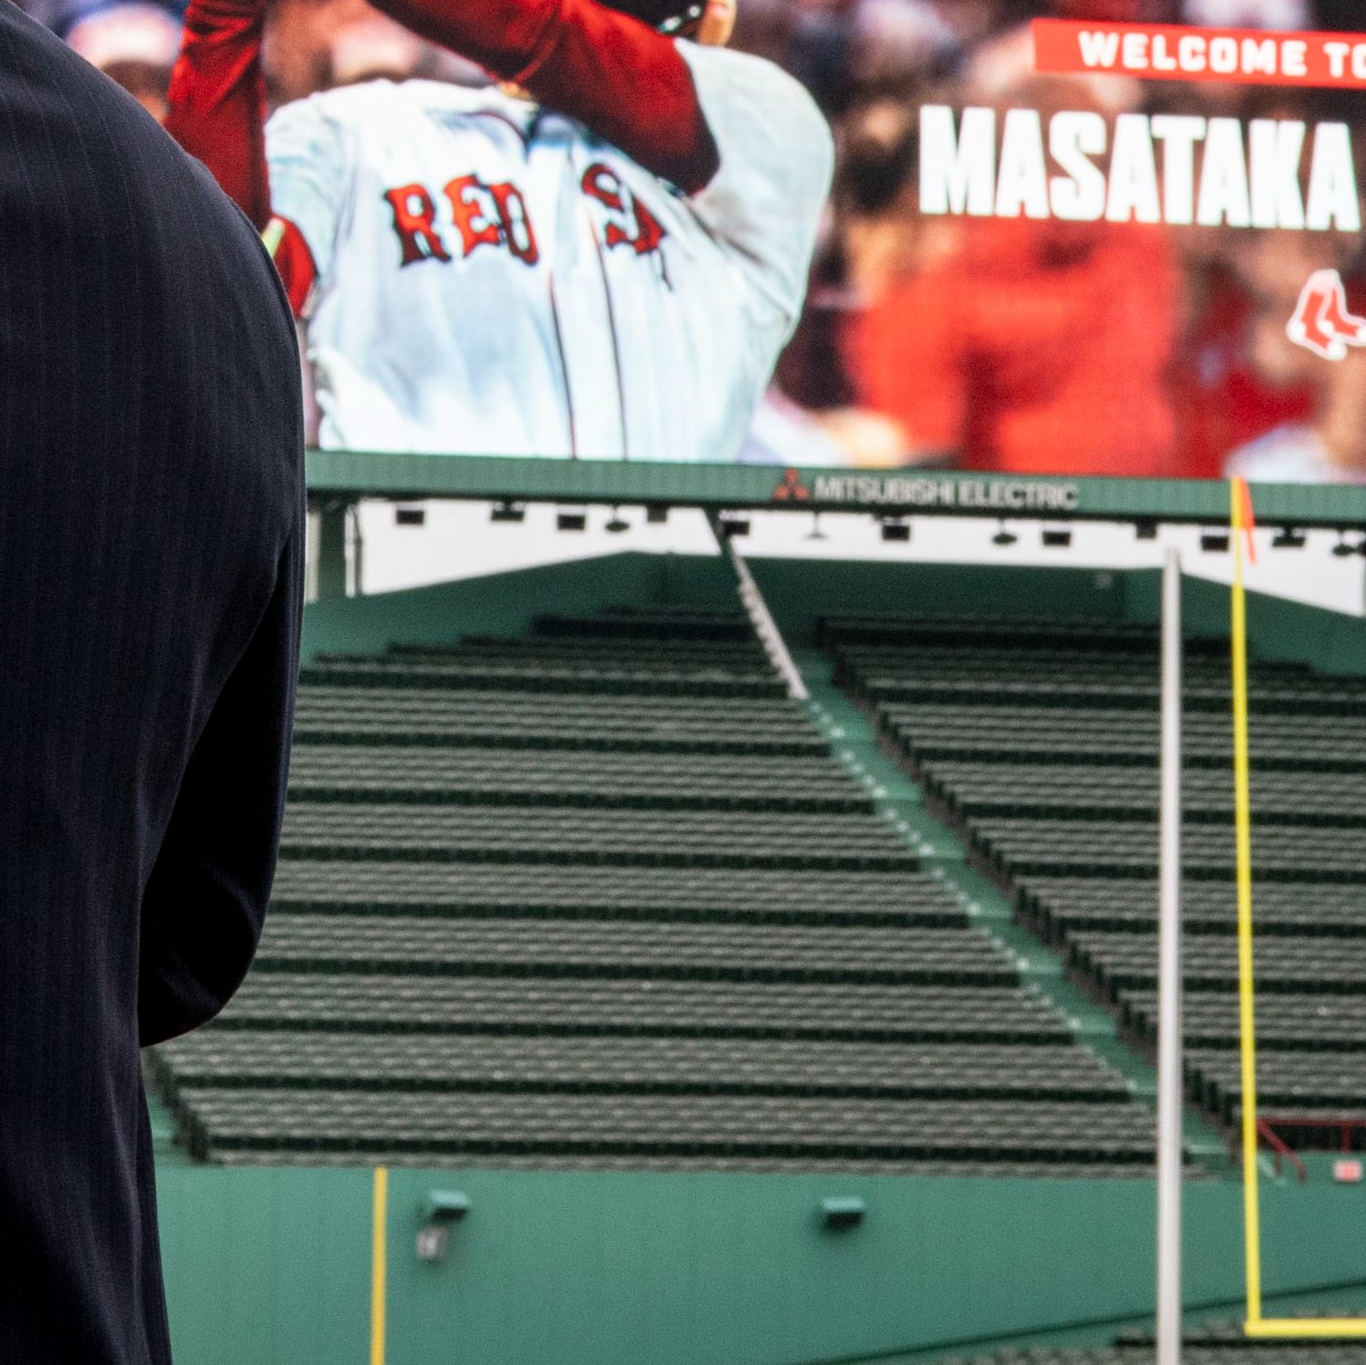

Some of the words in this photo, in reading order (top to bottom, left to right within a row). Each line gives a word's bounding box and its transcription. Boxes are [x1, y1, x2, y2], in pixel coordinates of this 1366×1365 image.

[1078, 30, 1307, 76] WELCOME
[918, 104, 1361, 233] MASATAKA
[382, 173, 539, 268] RED
[814, 476, 955, 506] MITSUBISHI
[958, 481, 1079, 511] ELECTRIC
